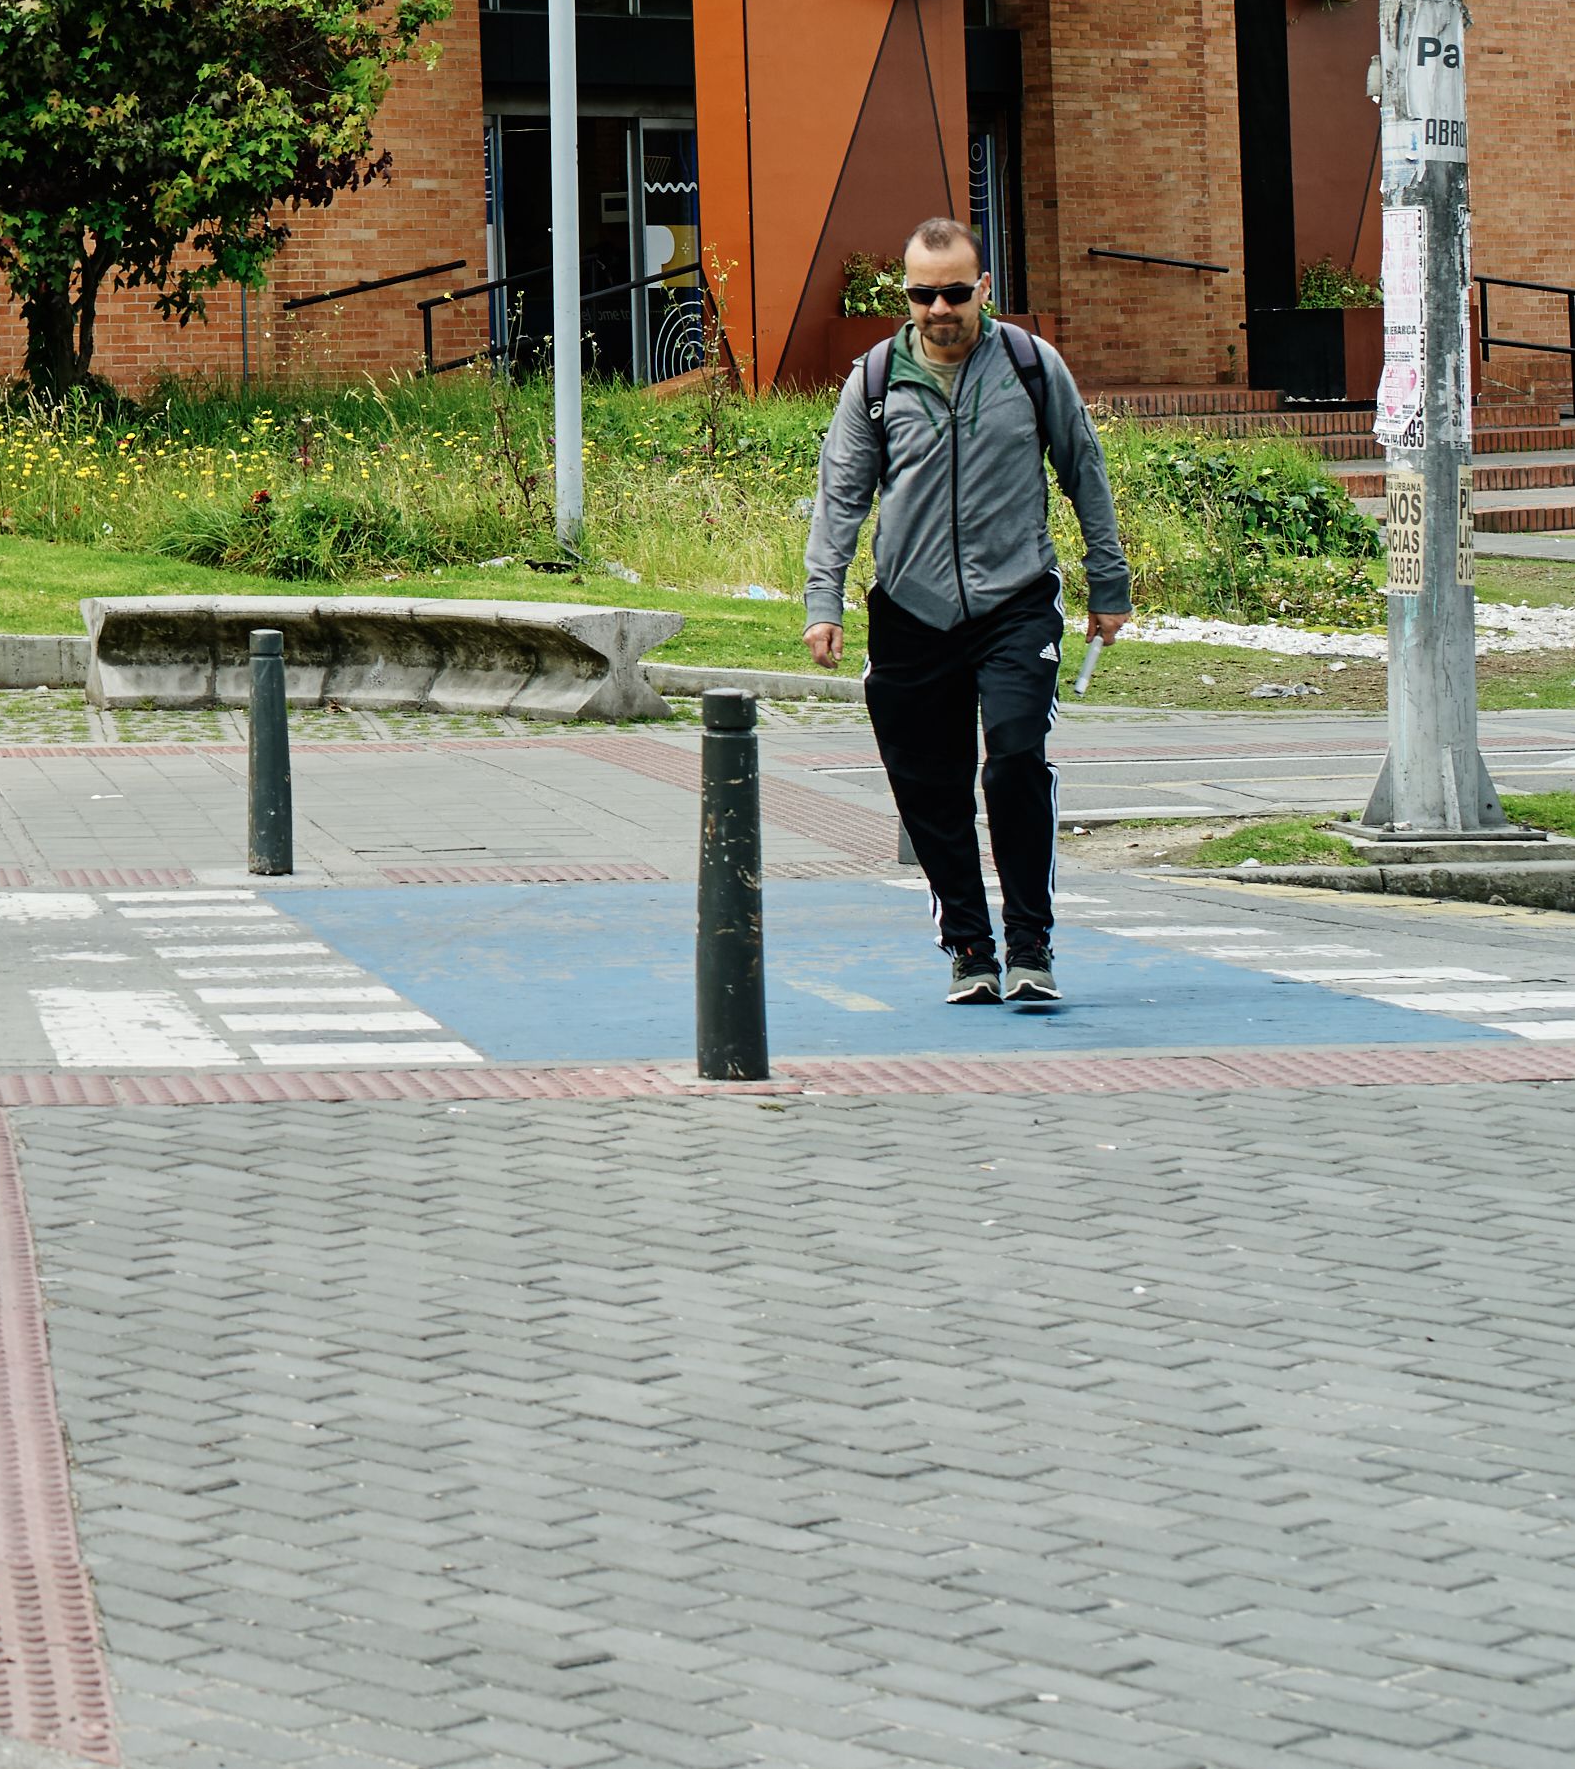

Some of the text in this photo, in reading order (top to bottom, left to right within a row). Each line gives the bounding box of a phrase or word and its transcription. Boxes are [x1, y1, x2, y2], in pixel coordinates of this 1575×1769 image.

[1412, 118, 1467, 148] ABRO
[1394, 482, 1421, 492] URBANA
[1387, 492, 1422, 526] NOS
